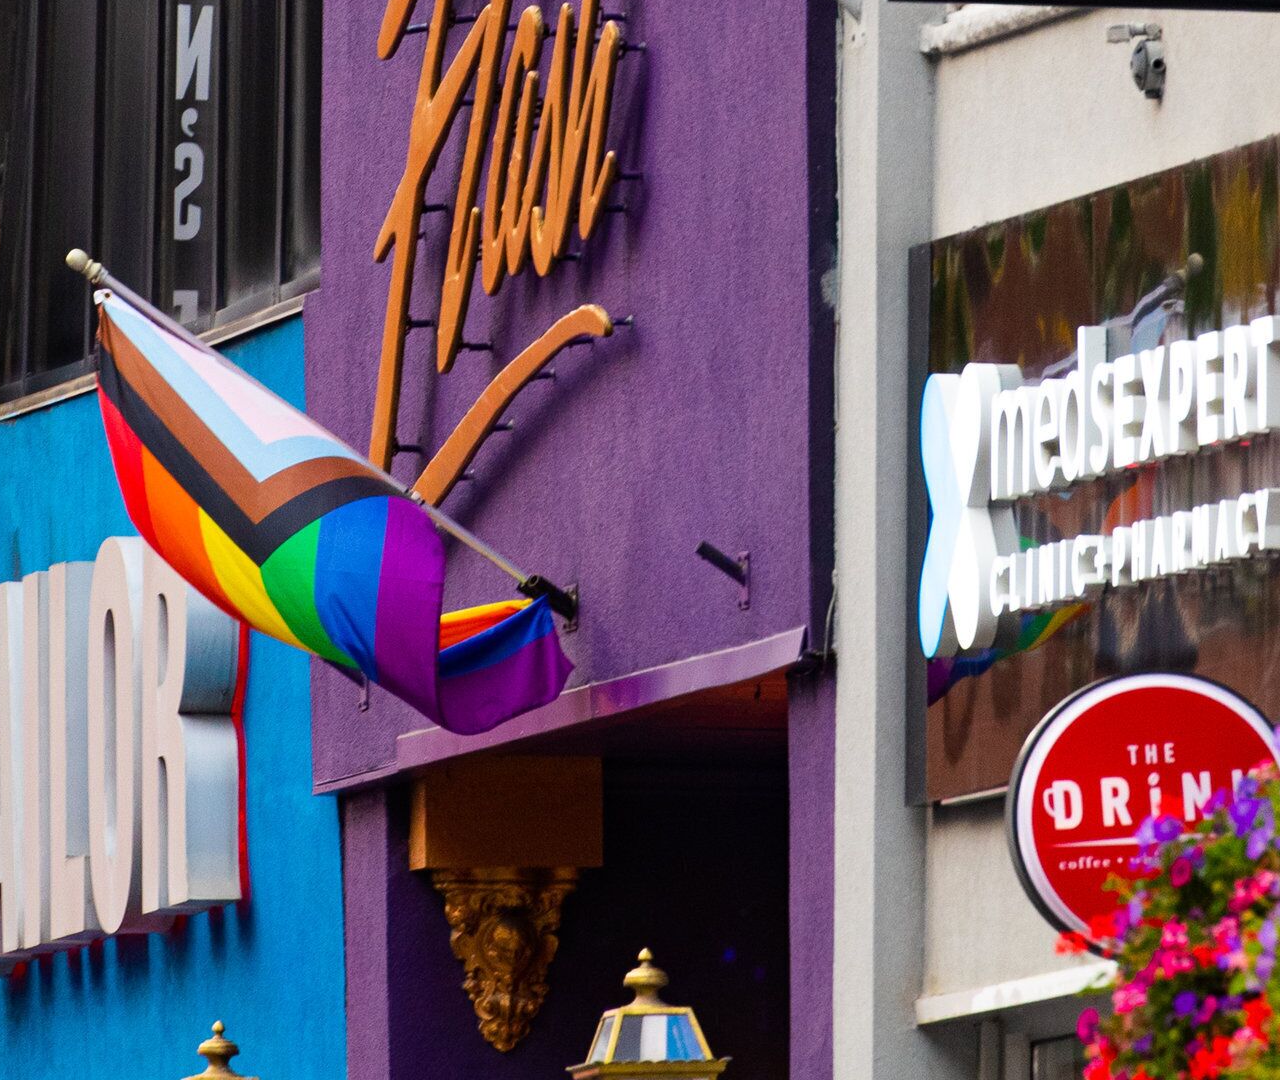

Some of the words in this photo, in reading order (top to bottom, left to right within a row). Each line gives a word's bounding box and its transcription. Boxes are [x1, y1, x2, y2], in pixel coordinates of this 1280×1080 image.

[989, 534, 1086, 618] CLINIC
[1126, 742, 1176, 766] THE
[1058, 855, 1111, 871] coffee
